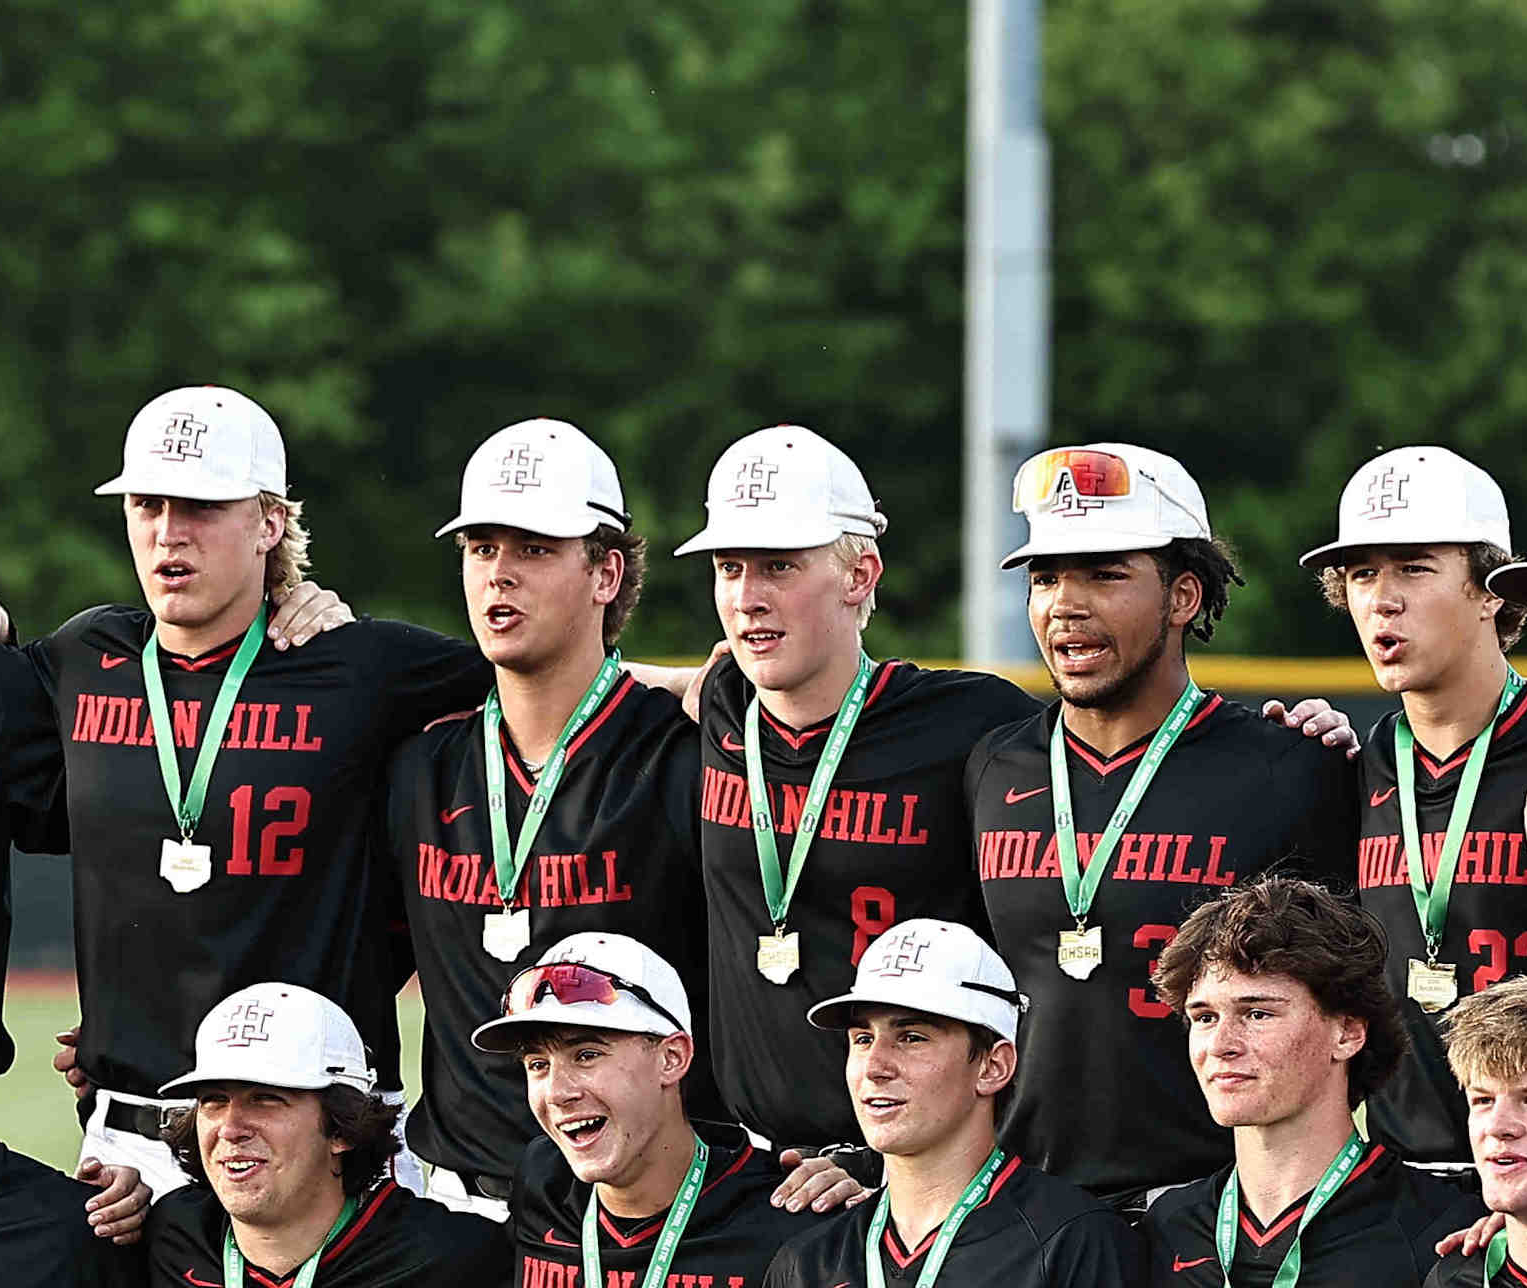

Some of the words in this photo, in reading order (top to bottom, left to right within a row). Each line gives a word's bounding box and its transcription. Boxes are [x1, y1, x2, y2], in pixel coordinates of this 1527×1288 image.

[227, 785, 312, 875] 12
[820, 790, 928, 845] HILL
[539, 851, 632, 908] HILL
[1112, 834, 1235, 887] HILL
